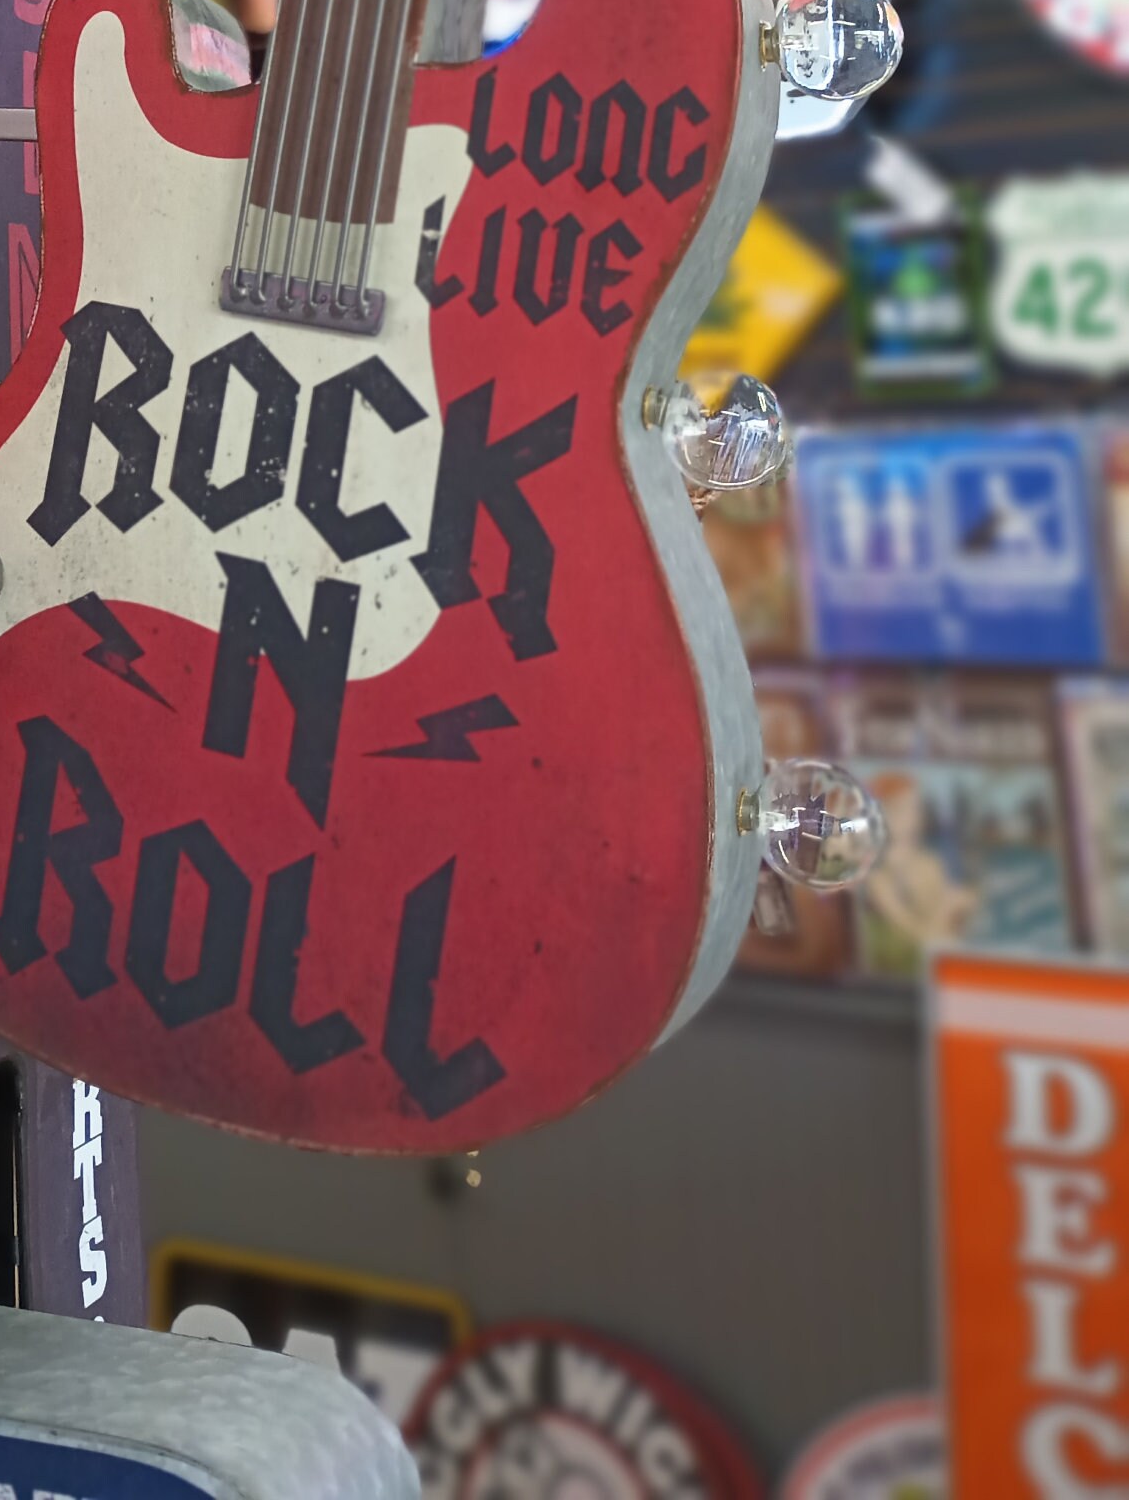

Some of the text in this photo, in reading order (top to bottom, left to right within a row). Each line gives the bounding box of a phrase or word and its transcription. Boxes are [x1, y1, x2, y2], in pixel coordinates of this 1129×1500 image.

[467, 66, 709, 202] LONG
[415, 195, 643, 337] LIVE
[26, 300, 578, 662] ROCK
[201, 550, 361, 831] N
